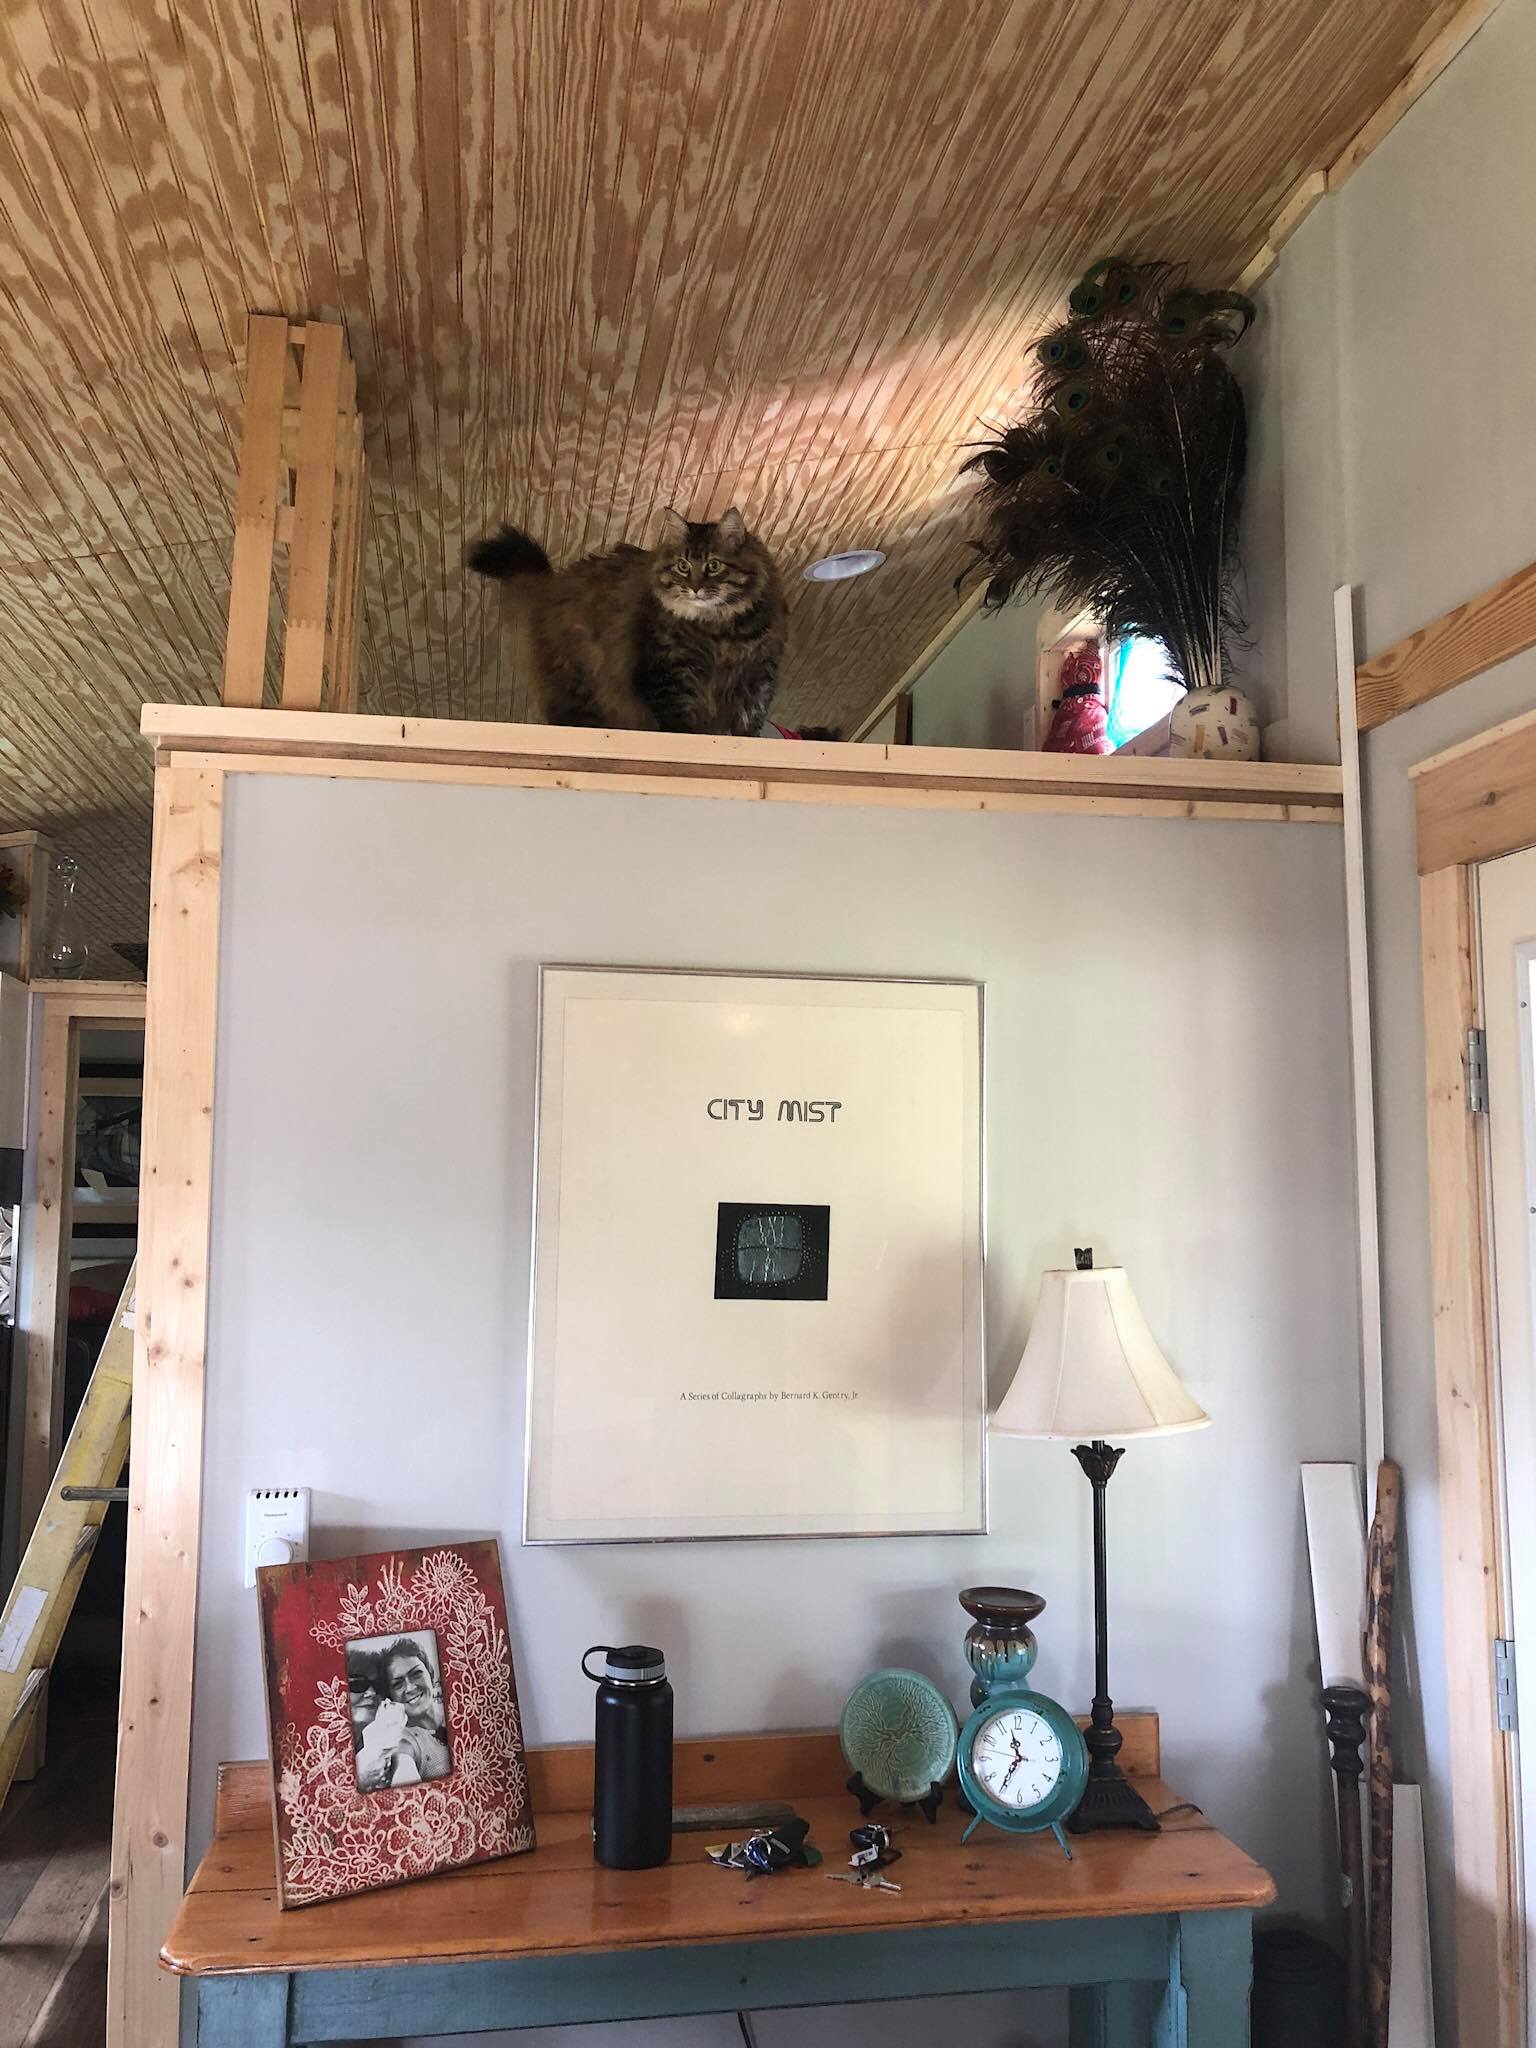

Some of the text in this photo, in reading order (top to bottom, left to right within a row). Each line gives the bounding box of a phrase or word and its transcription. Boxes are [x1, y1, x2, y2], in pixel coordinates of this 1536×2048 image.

[707, 1098, 842, 1122] CITY MIST
[680, 1392, 687, 1401] A
[688, 1391, 710, 1400] Series
[711, 1392, 719, 1400] of
[721, 1391, 767, 1403] Collagraphs
[769, 1391, 778, 1402] by
[781, 1391, 811, 1400] Bernard
[996, 1720, 1007, 1735] 11
[1014, 1715, 1022, 1730] 12
[1030, 1722, 1038, 1734] 1
[983, 1735, 996, 1747] 10
[1040, 1735, 1053, 1746] 2
[985, 1772, 996, 1782] 8
[1042, 1773, 1054, 1782] 4
[1017, 1788, 1023, 1803] 6
[1032, 1784, 1041, 1798] 5
